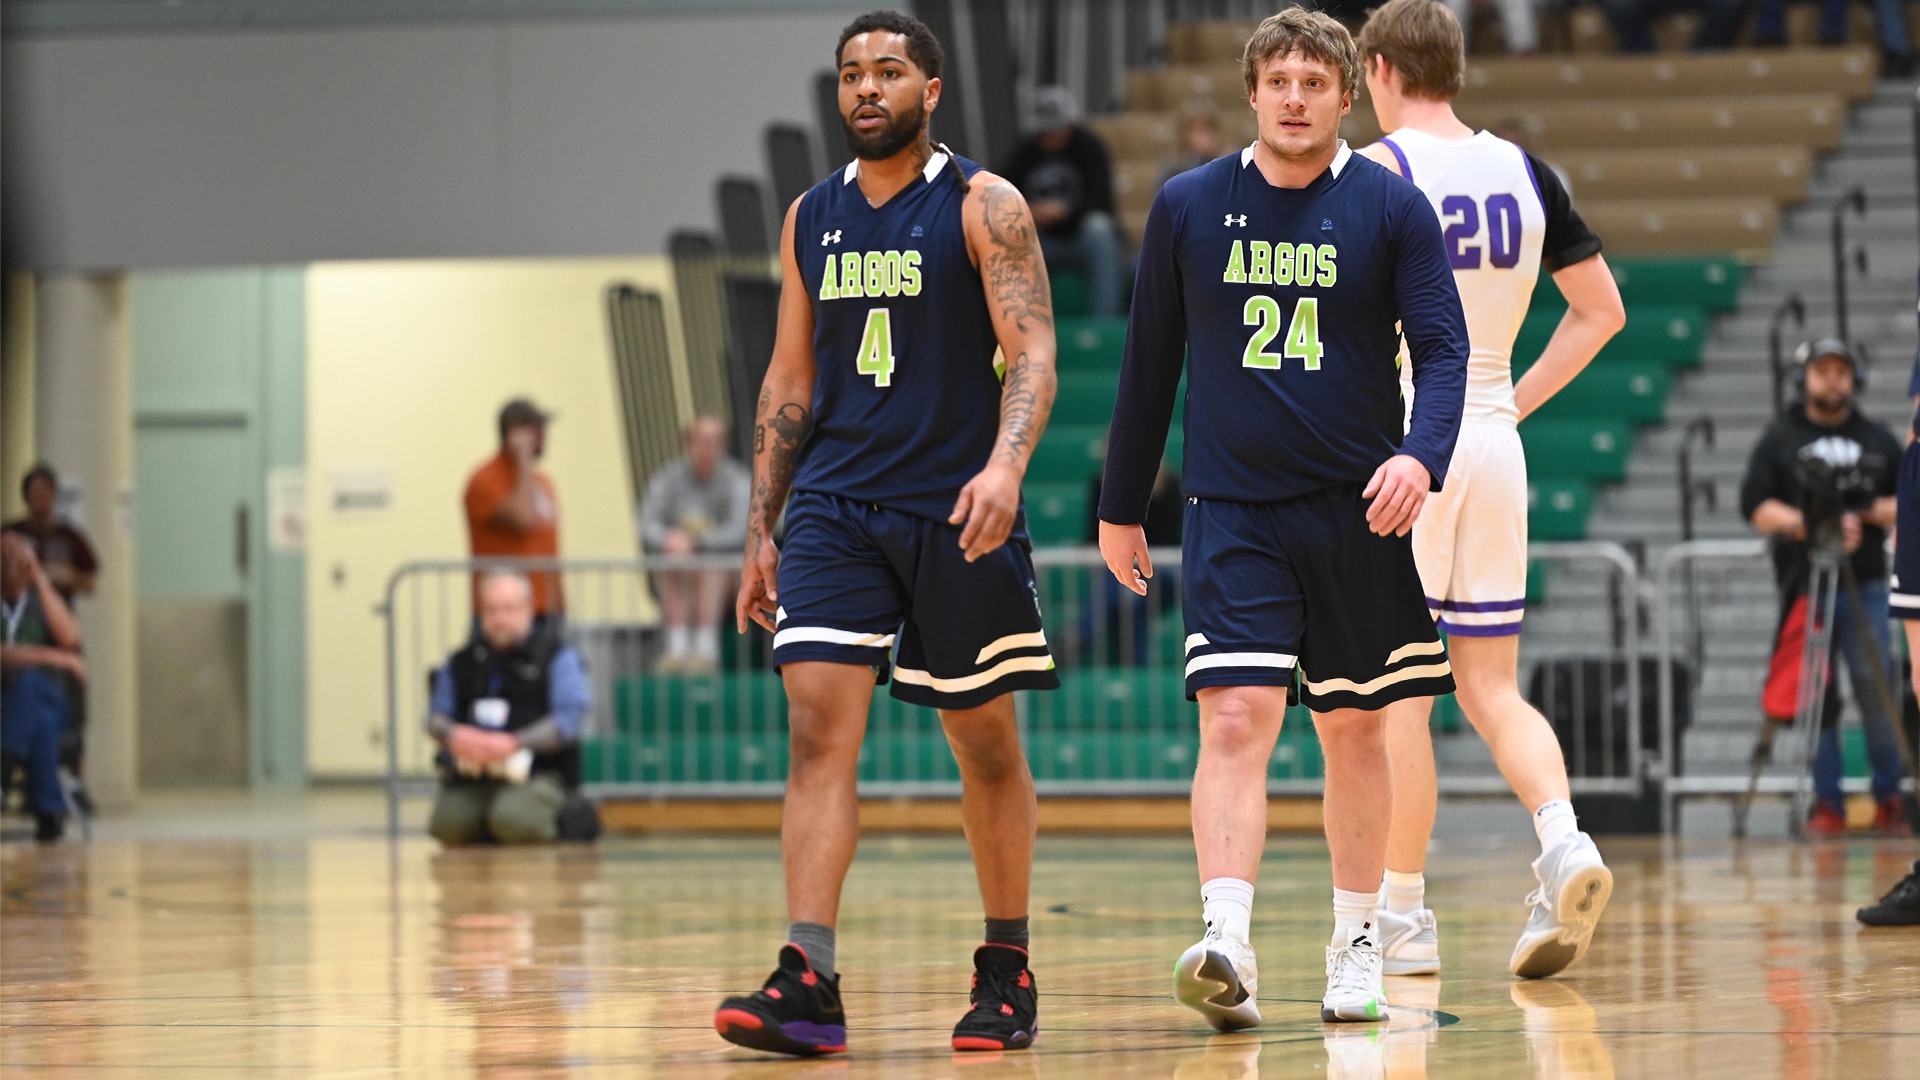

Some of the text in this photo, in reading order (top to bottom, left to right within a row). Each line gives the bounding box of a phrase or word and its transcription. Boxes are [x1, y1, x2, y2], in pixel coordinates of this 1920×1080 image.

[1223, 240, 1337, 286] ARGOS
[1442, 193, 1521, 269] 20
[820, 250, 922, 299] ARGOS
[856, 308, 895, 387] 4
[1242, 295, 1323, 371] 24
